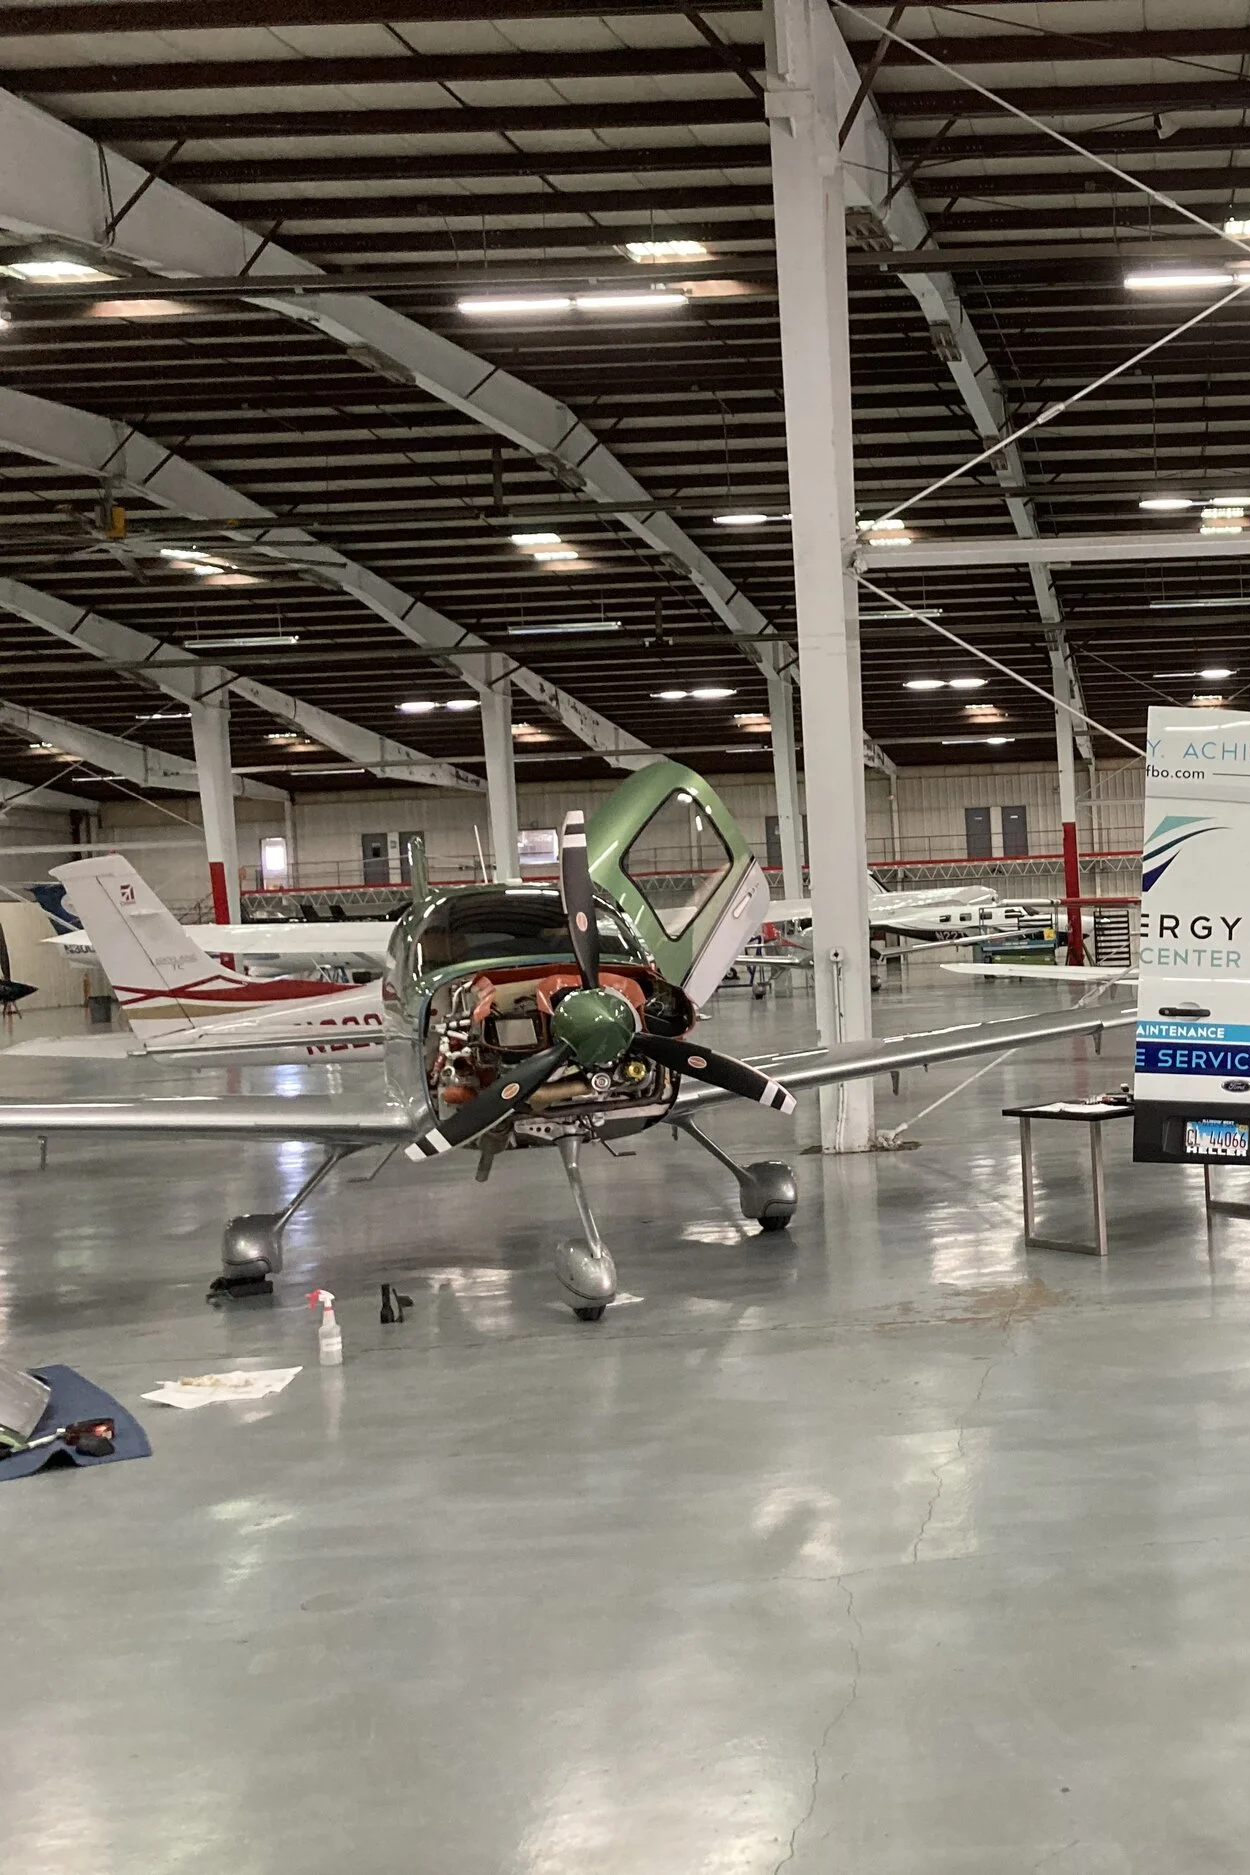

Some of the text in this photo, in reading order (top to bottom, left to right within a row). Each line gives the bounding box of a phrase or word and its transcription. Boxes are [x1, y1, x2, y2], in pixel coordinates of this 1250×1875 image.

[1139, 947, 1241, 969] CENTER
[1136, 1025, 1225, 1039] AINTENANCE
[1187, 1128, 1247, 1149] CL 44066
